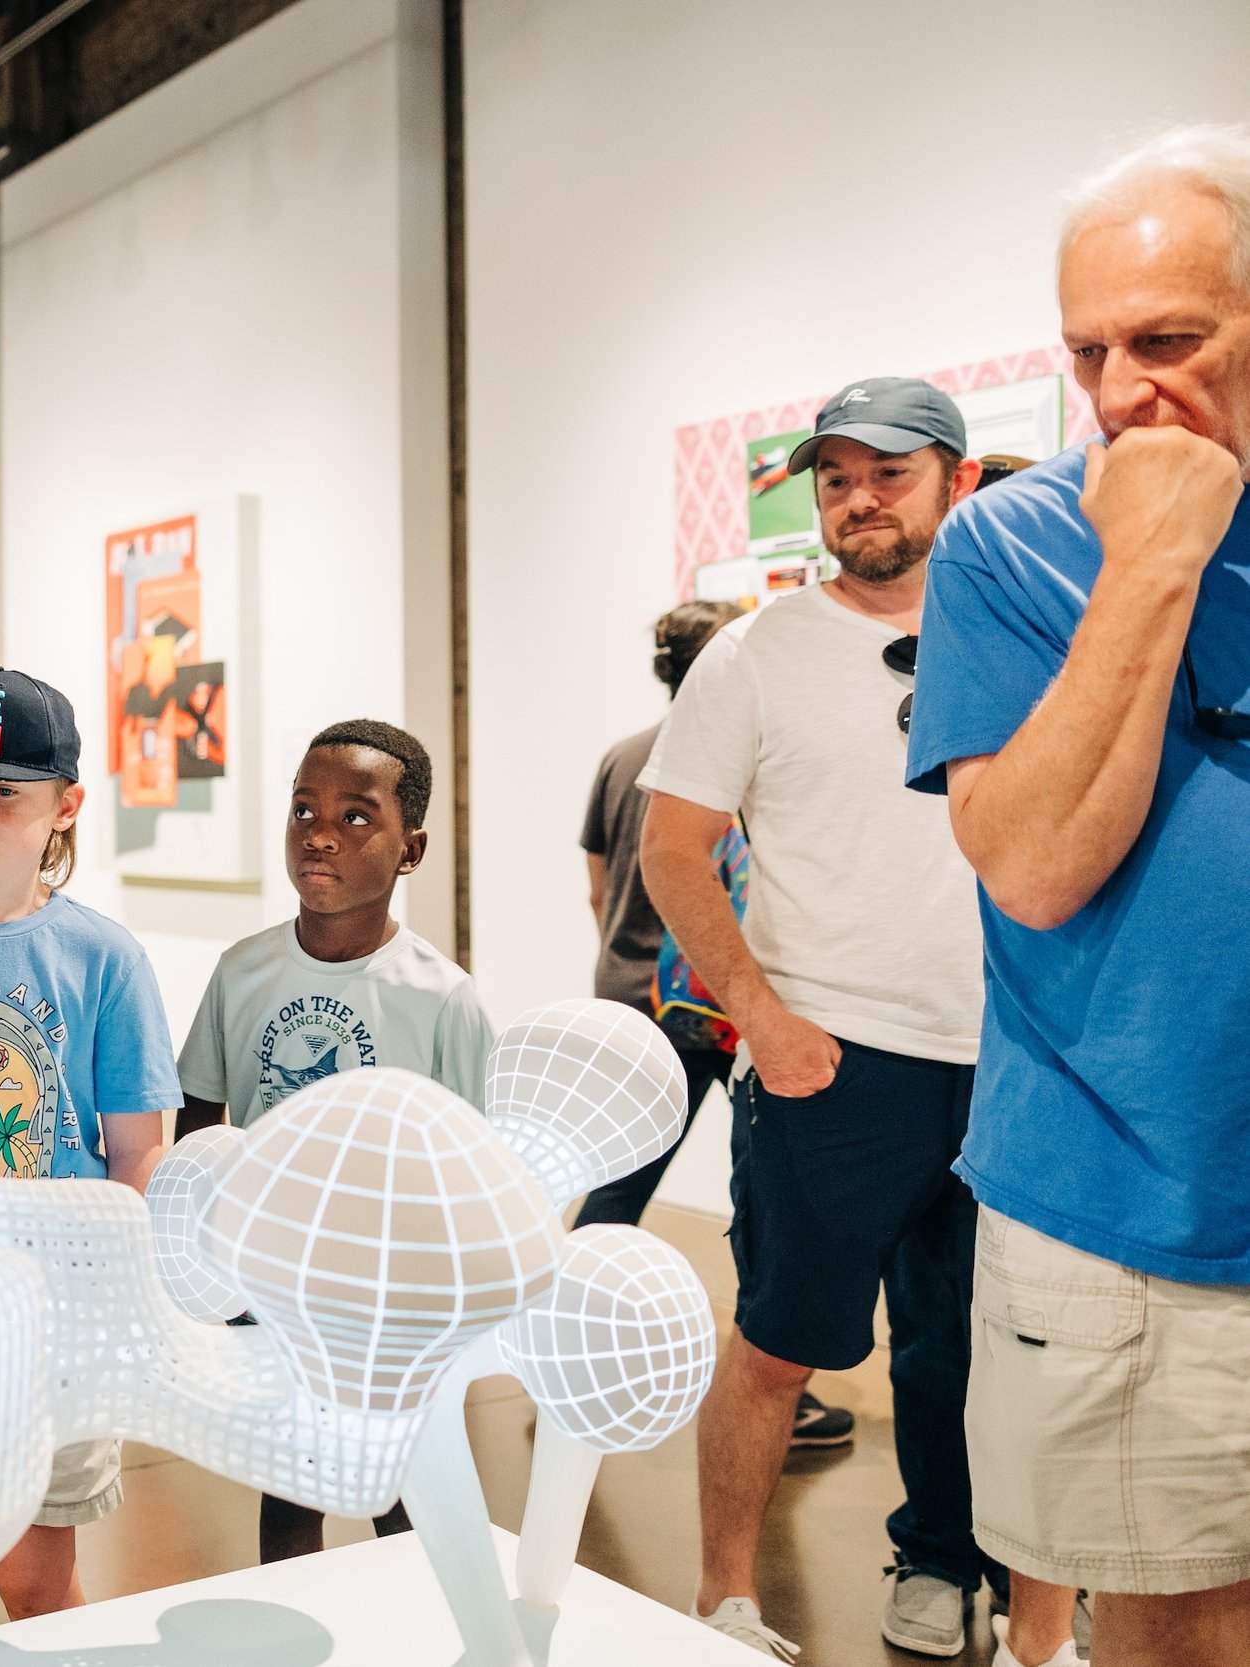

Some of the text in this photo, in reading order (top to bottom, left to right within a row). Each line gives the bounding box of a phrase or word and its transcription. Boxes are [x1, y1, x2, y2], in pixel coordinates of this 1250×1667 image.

[279, 997, 306, 1023] ON
[311, 995, 355, 1024] THE
[351, 1020, 377, 1068] WAT
[283, 1014, 352, 1045] SINCE 1938
